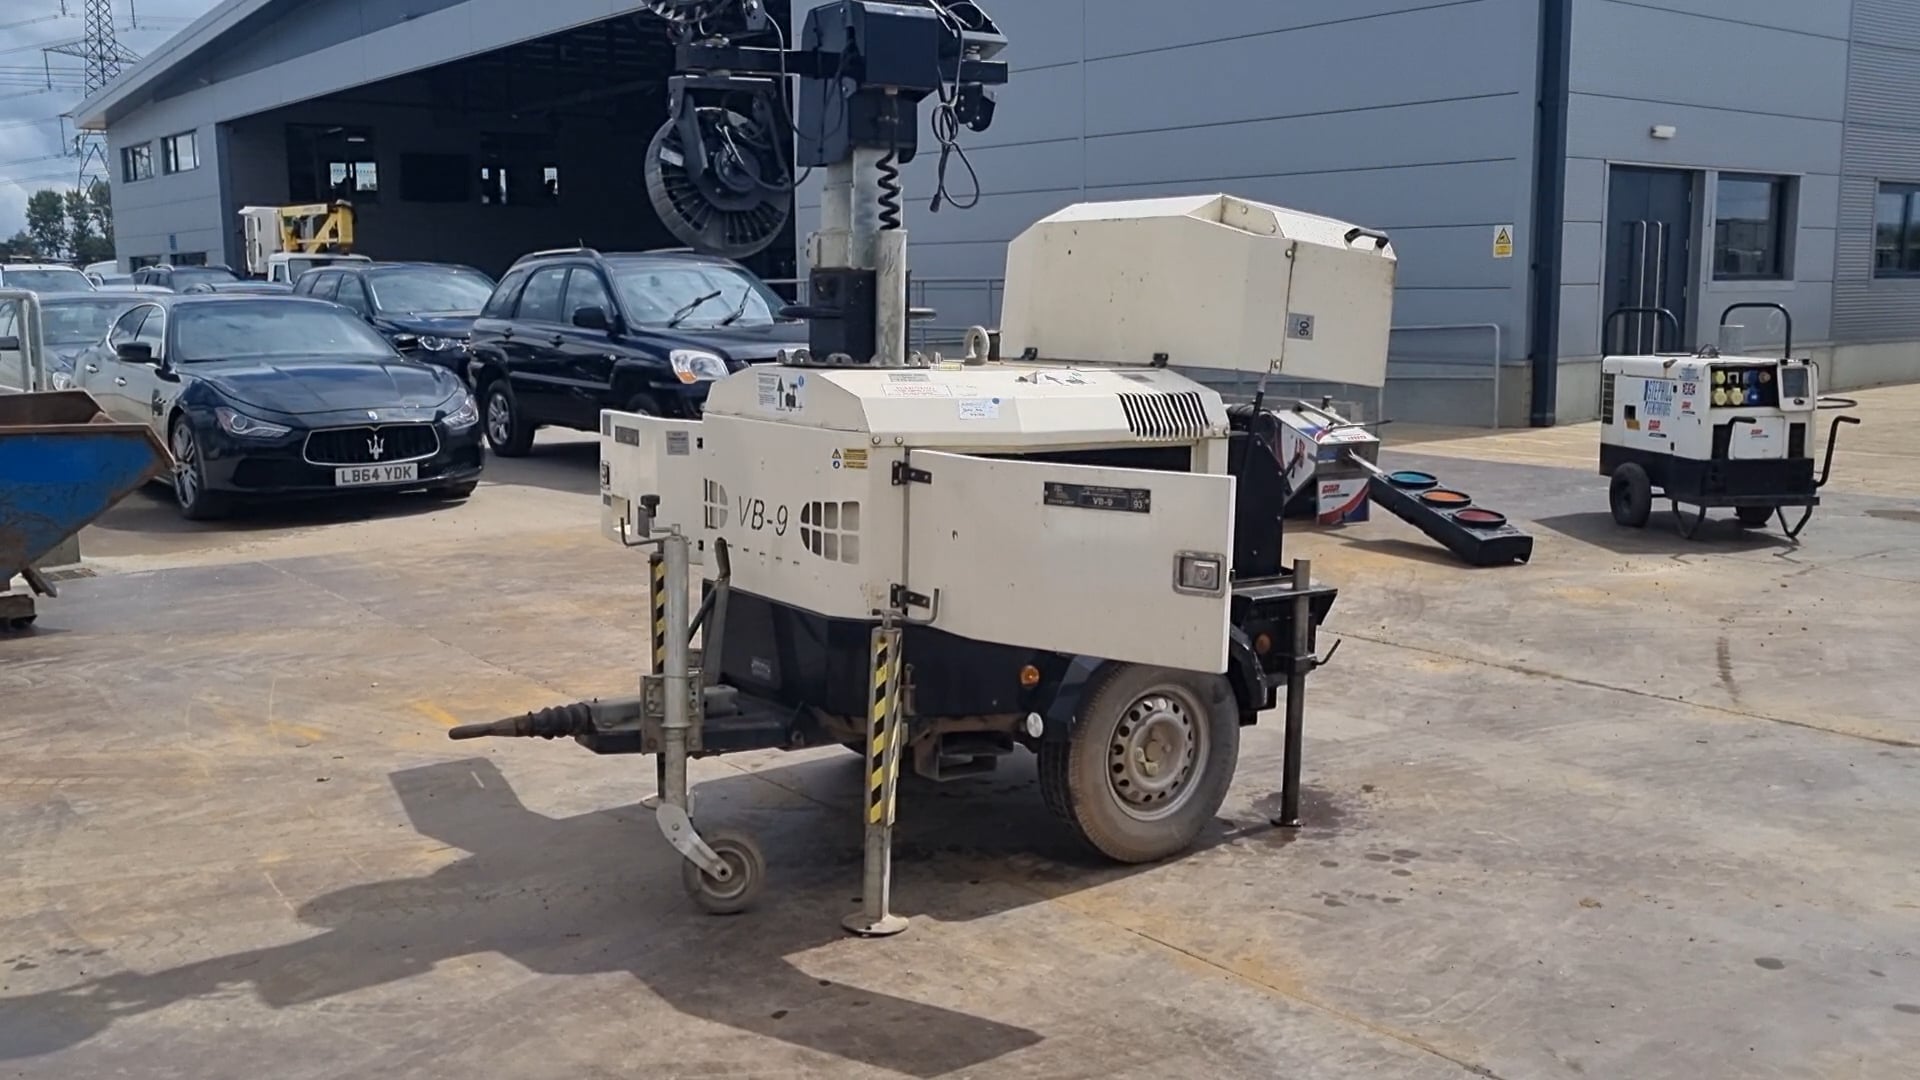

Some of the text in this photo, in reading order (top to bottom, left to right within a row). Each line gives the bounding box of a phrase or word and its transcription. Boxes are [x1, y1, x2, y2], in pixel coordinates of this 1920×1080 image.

[341, 466, 412, 483] LB64 YDK
[739, 495, 788, 536] VB-9
